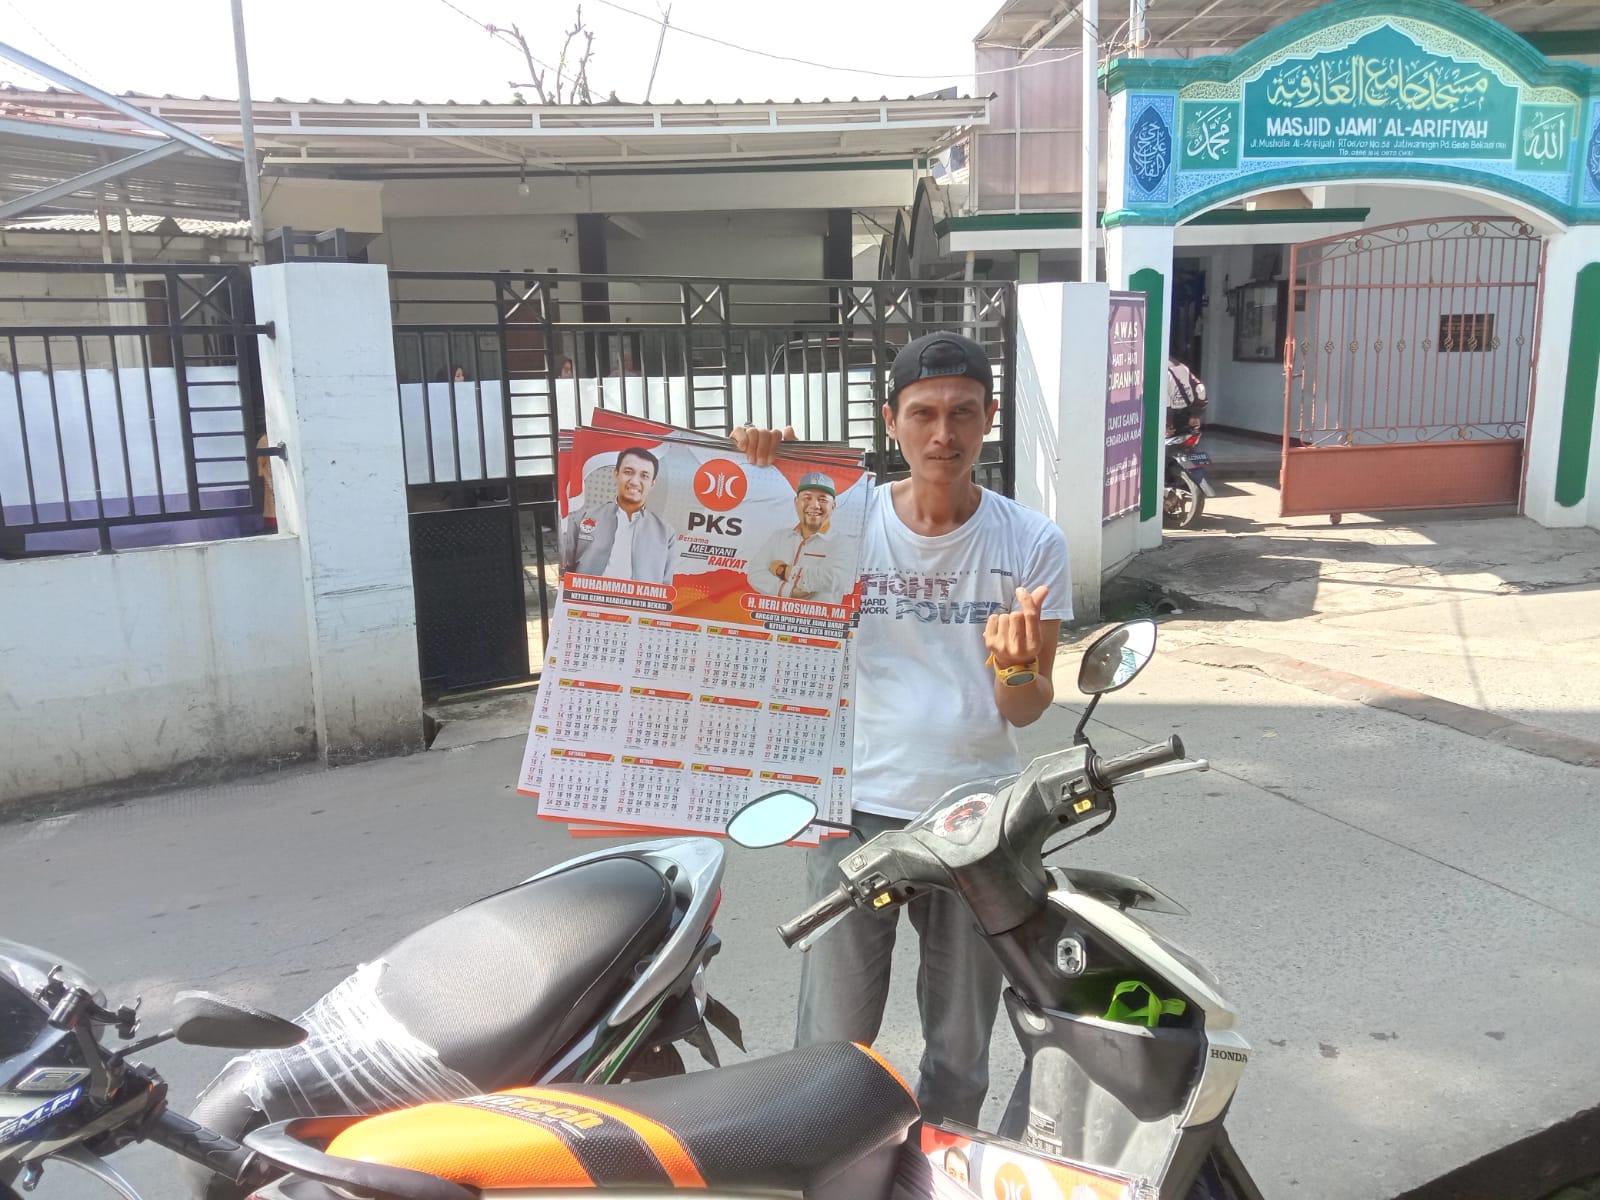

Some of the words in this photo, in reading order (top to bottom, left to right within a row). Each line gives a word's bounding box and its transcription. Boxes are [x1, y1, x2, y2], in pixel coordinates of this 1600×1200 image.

[1267, 117, 1331, 137] MASJID
[1335, 117, 1382, 137] JAMI'
[1385, 118, 1488, 139] AL-ARIFIYAH
[1114, 321, 1138, 338] AWAS
[688, 512, 743, 536] PKS
[678, 534, 709, 544] Bersama
[691, 544, 735, 557] MELAYANI
[708, 556, 748, 569] RAKYAT
[572, 577, 635, 594] MUHAMMAD
[636, 585, 668, 599] KAMIL
[860, 573, 957, 600] FIGHT
[647, 601, 667, 610] BEKASI
[748, 597, 757, 608] H.
[759, 598, 779, 611] HERI
[782, 600, 829, 618] KOSWARA,
[832, 607, 846, 620] MA
[859, 606, 888, 615] WORK
[824, 629, 843, 638] BEKASI
[1210, 1049, 1248, 1062] HONDA
